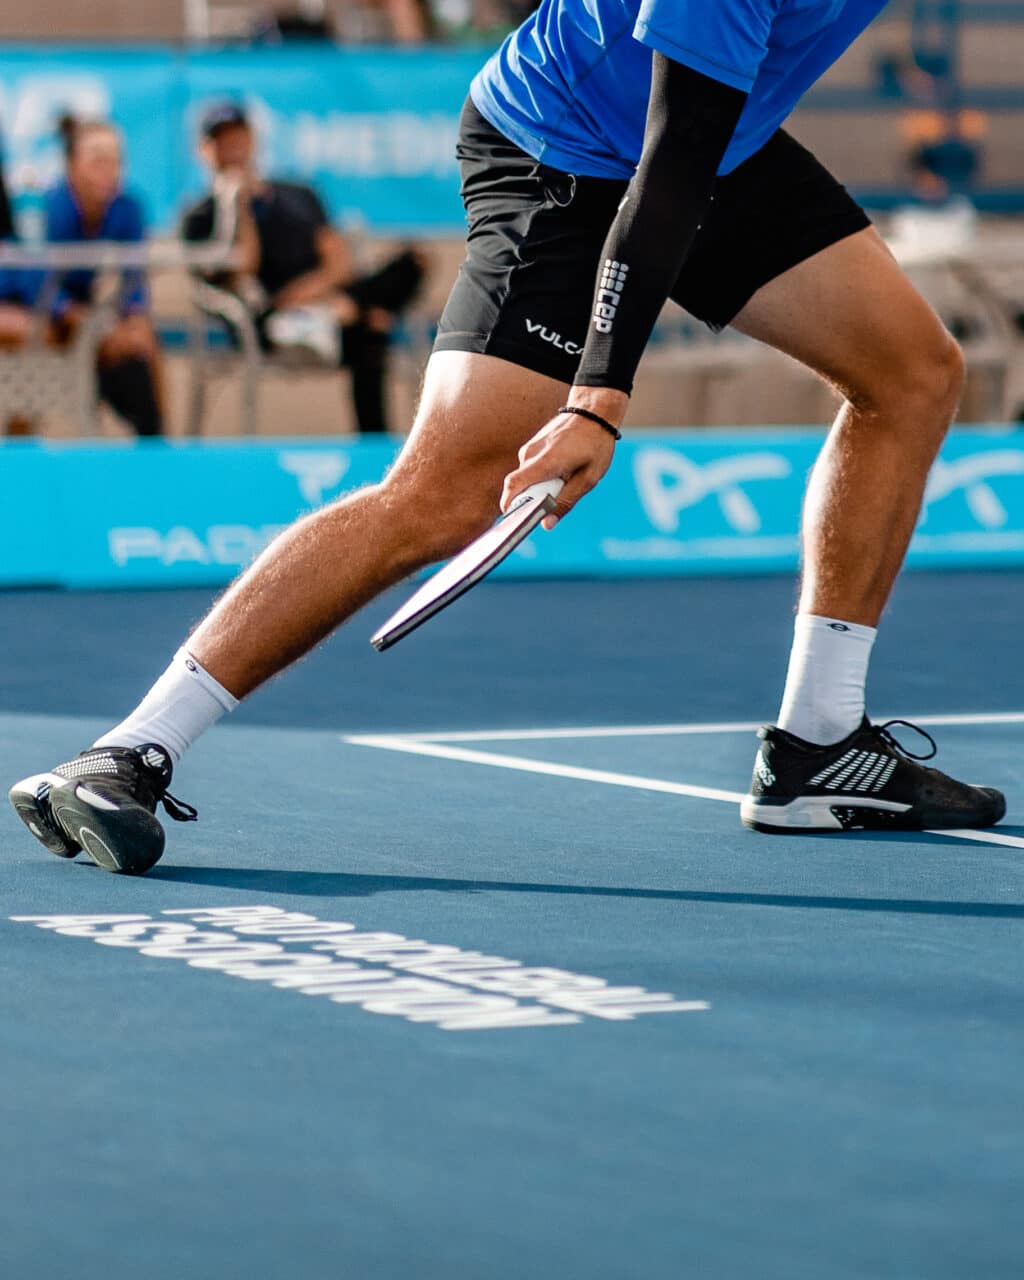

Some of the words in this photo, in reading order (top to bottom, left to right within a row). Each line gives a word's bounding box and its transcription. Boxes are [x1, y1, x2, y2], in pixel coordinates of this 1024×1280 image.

[8, 913, 585, 1031] ASSOCIATION
[159, 905, 357, 935] PRO
[276, 931, 712, 1020] PICKLEBALL
